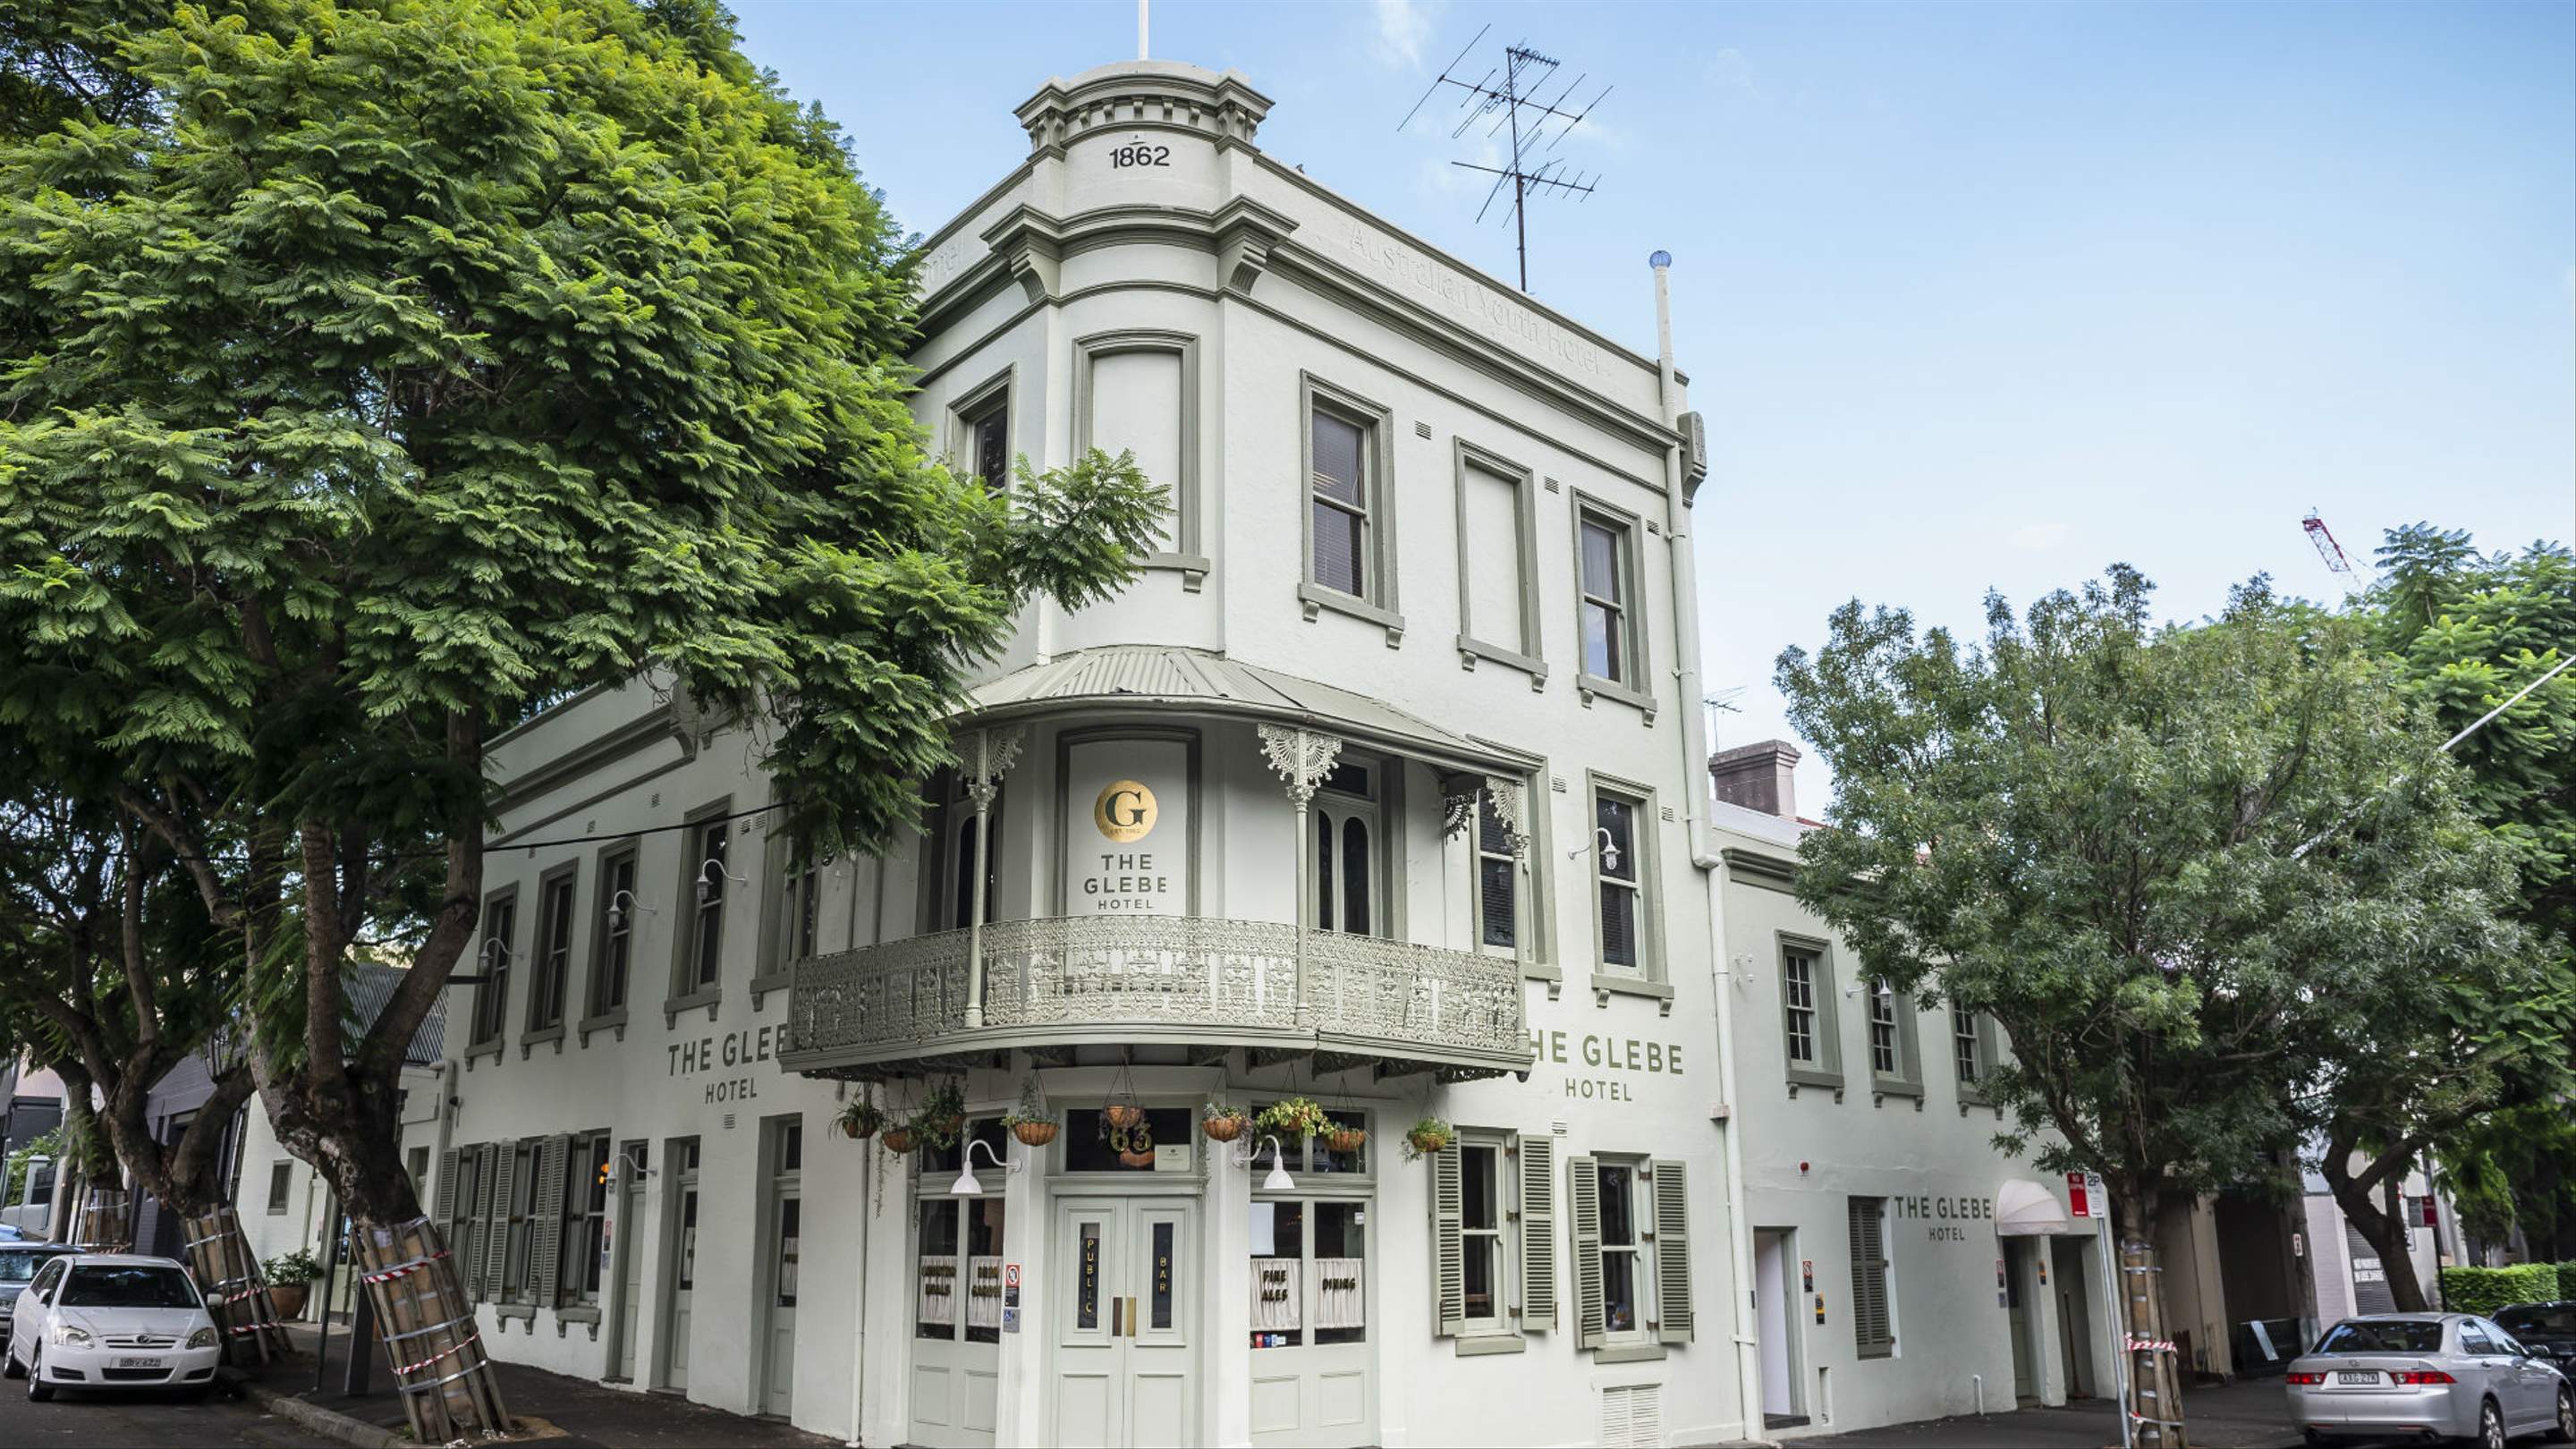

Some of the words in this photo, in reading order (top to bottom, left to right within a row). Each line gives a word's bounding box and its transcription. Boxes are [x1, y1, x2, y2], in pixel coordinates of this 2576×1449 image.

[1109, 146, 1170, 169] 1862
[1105, 791, 1146, 827] G
[1101, 854, 1152, 870] THE
[1084, 877, 1166, 894] GLEBE
[1098, 899, 1154, 911] HOTEL
[668, 1038, 713, 1077] THE
[1530, 1030, 1568, 1063] HE
[1582, 1034, 1683, 1075] GLEBE
[705, 1077, 758, 1105] HOTEL
[1565, 1078, 1632, 1102] HOTEL
[2087, 1174, 2100, 1187] 2P
[1894, 1196, 1931, 1219] THE
[1936, 1196, 1992, 1220] GLEBE
[1928, 1226, 1965, 1241] HOTEL
[1085, 1239, 1094, 1313] PUBLIC
[1263, 1270, 1286, 1283] FINE
[1322, 1277, 1356, 1291] DINING
[1261, 1289, 1288, 1301] ALES
